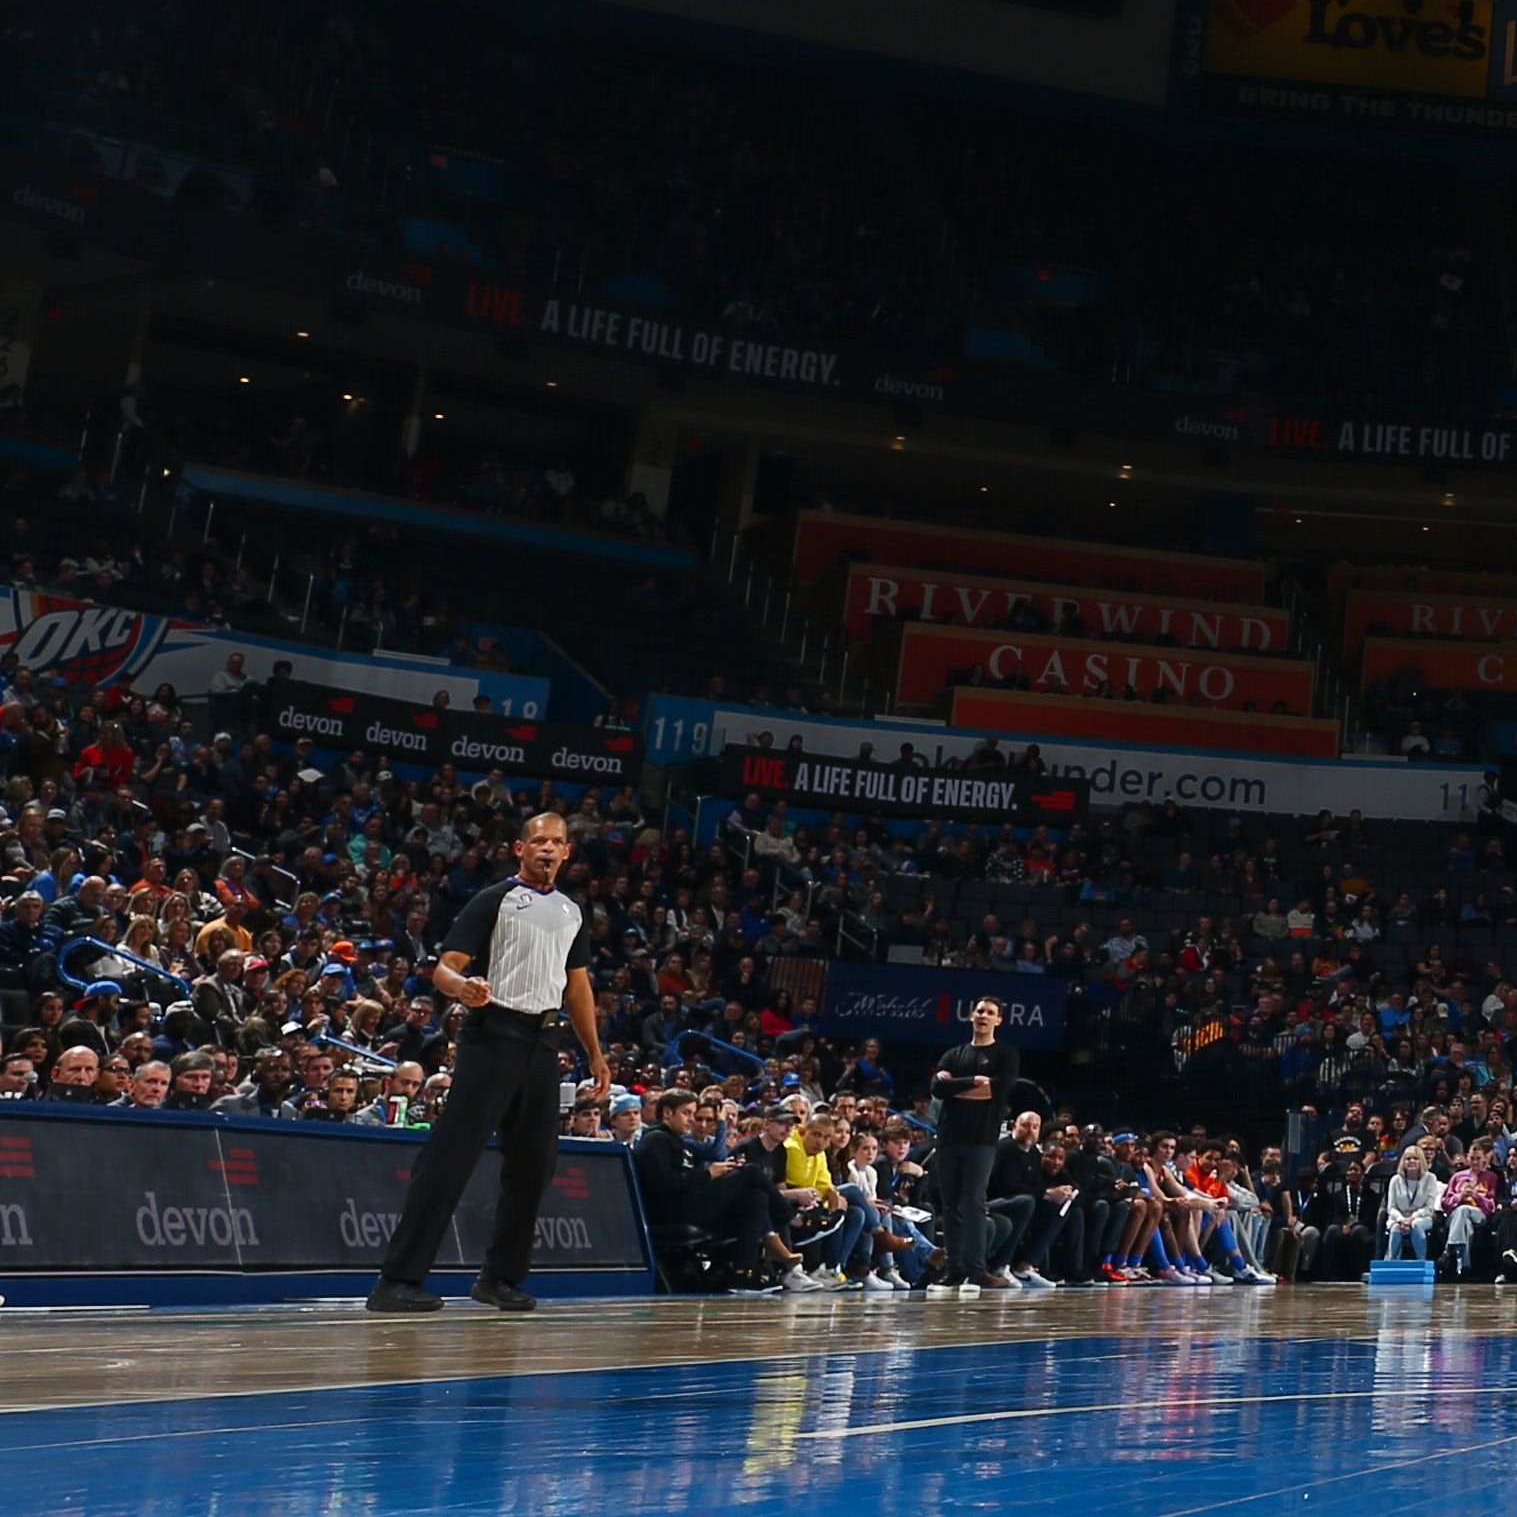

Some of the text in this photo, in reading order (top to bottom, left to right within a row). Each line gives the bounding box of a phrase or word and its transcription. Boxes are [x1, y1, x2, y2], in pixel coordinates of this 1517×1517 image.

[1238, 85, 1331, 112] BRING
[1341, 94, 1397, 118] THE
[13, 186, 87, 223] devon
[346, 271, 944, 401] devon LIVE. A LIFE FULL OF ENERGY. devon
[1176, 416, 1239, 440] devon
[1270, 418, 1330, 448] LIVE.
[1338, 422, 1355, 450] A
[1362, 424, 1411, 455] LIFE
[1418, 427, 1474, 460] FULL
[1481, 430, 1511, 461] OF
[989, 644, 1236, 701] CASINO
[278, 705, 622, 774] devon devon devon devon
[653, 717, 708, 754] 119
[743, 755, 1017, 811] LIVE. A LIFE FULL OF ENERGY.
[136, 1191, 260, 1247] devon
